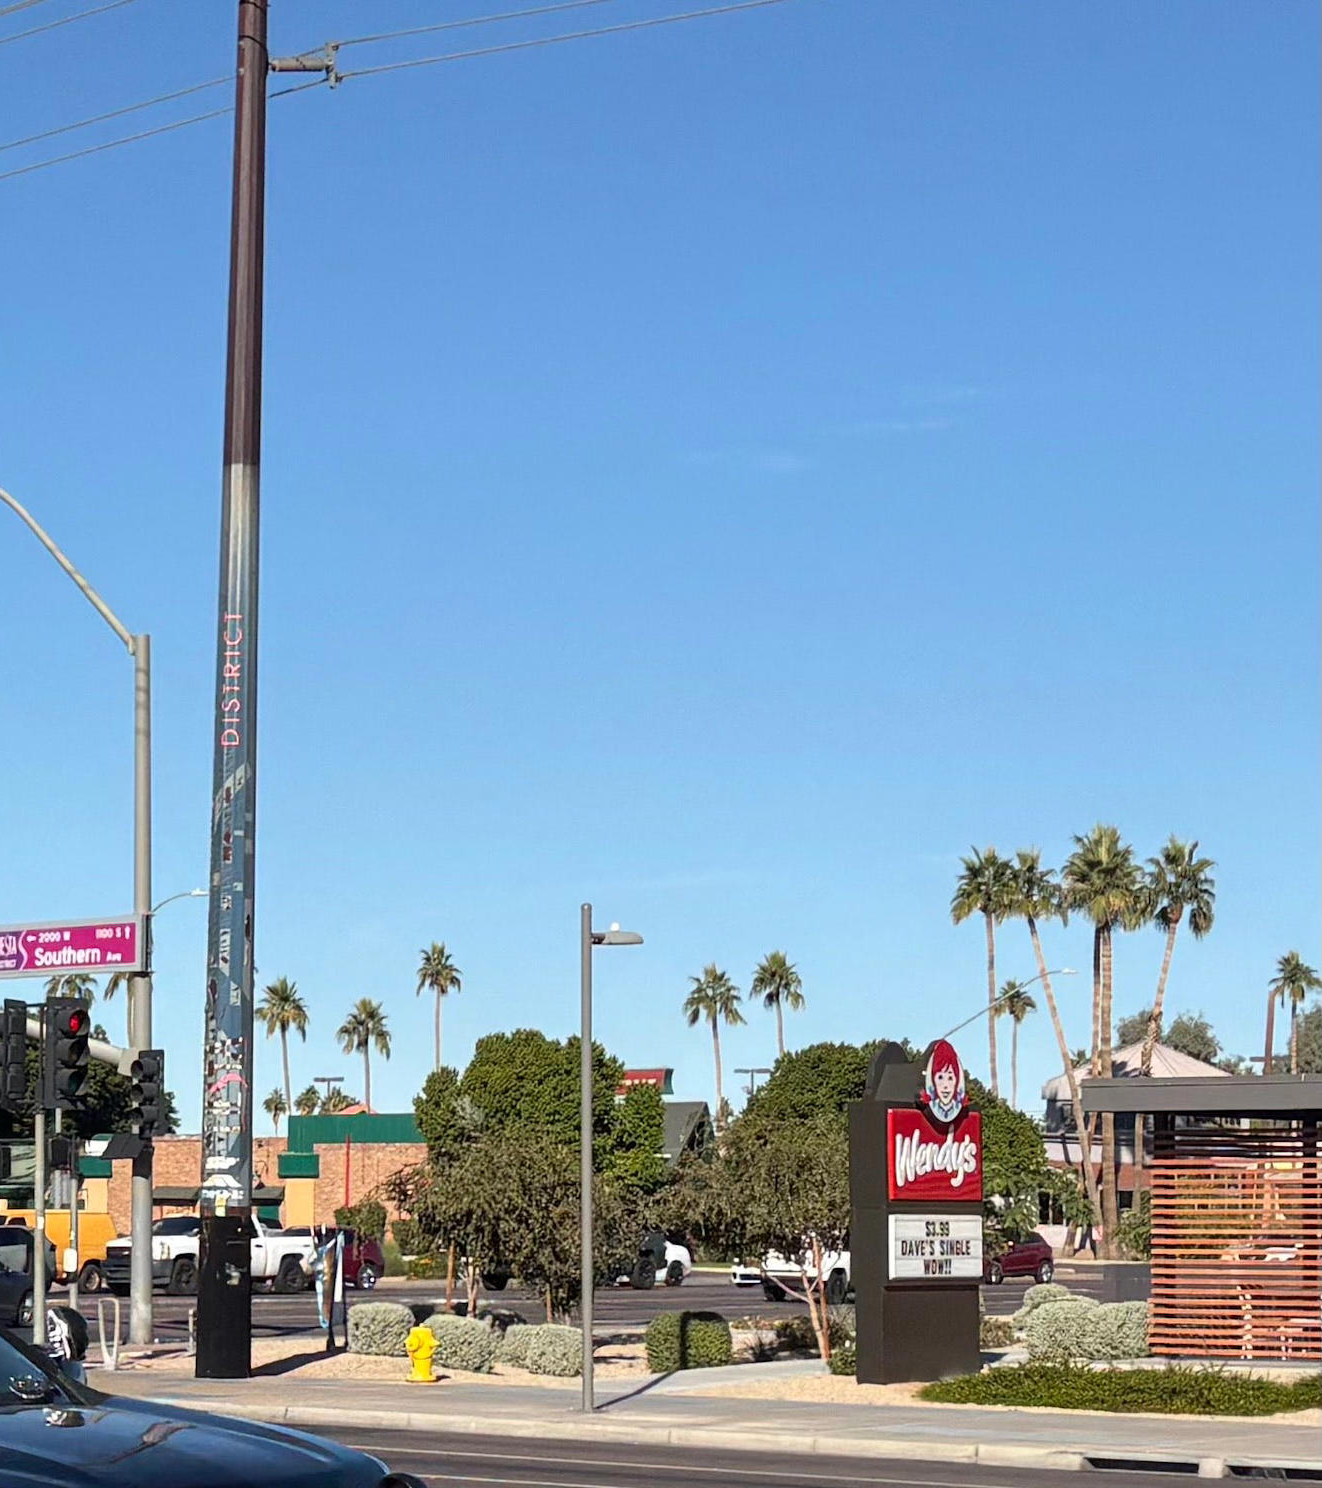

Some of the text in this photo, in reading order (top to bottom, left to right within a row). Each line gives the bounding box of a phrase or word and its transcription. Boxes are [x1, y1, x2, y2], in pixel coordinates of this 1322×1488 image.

[220, 612, 243, 747] DISTRICT
[34, 946, 101, 967] Southern
[895, 1124, 977, 1188] Wendy's
[925, 1221, 950, 1237] $3.99
[901, 1240, 971, 1256] DAVE'S SINGLE
[923, 1259, 952, 1275] WOW!!
